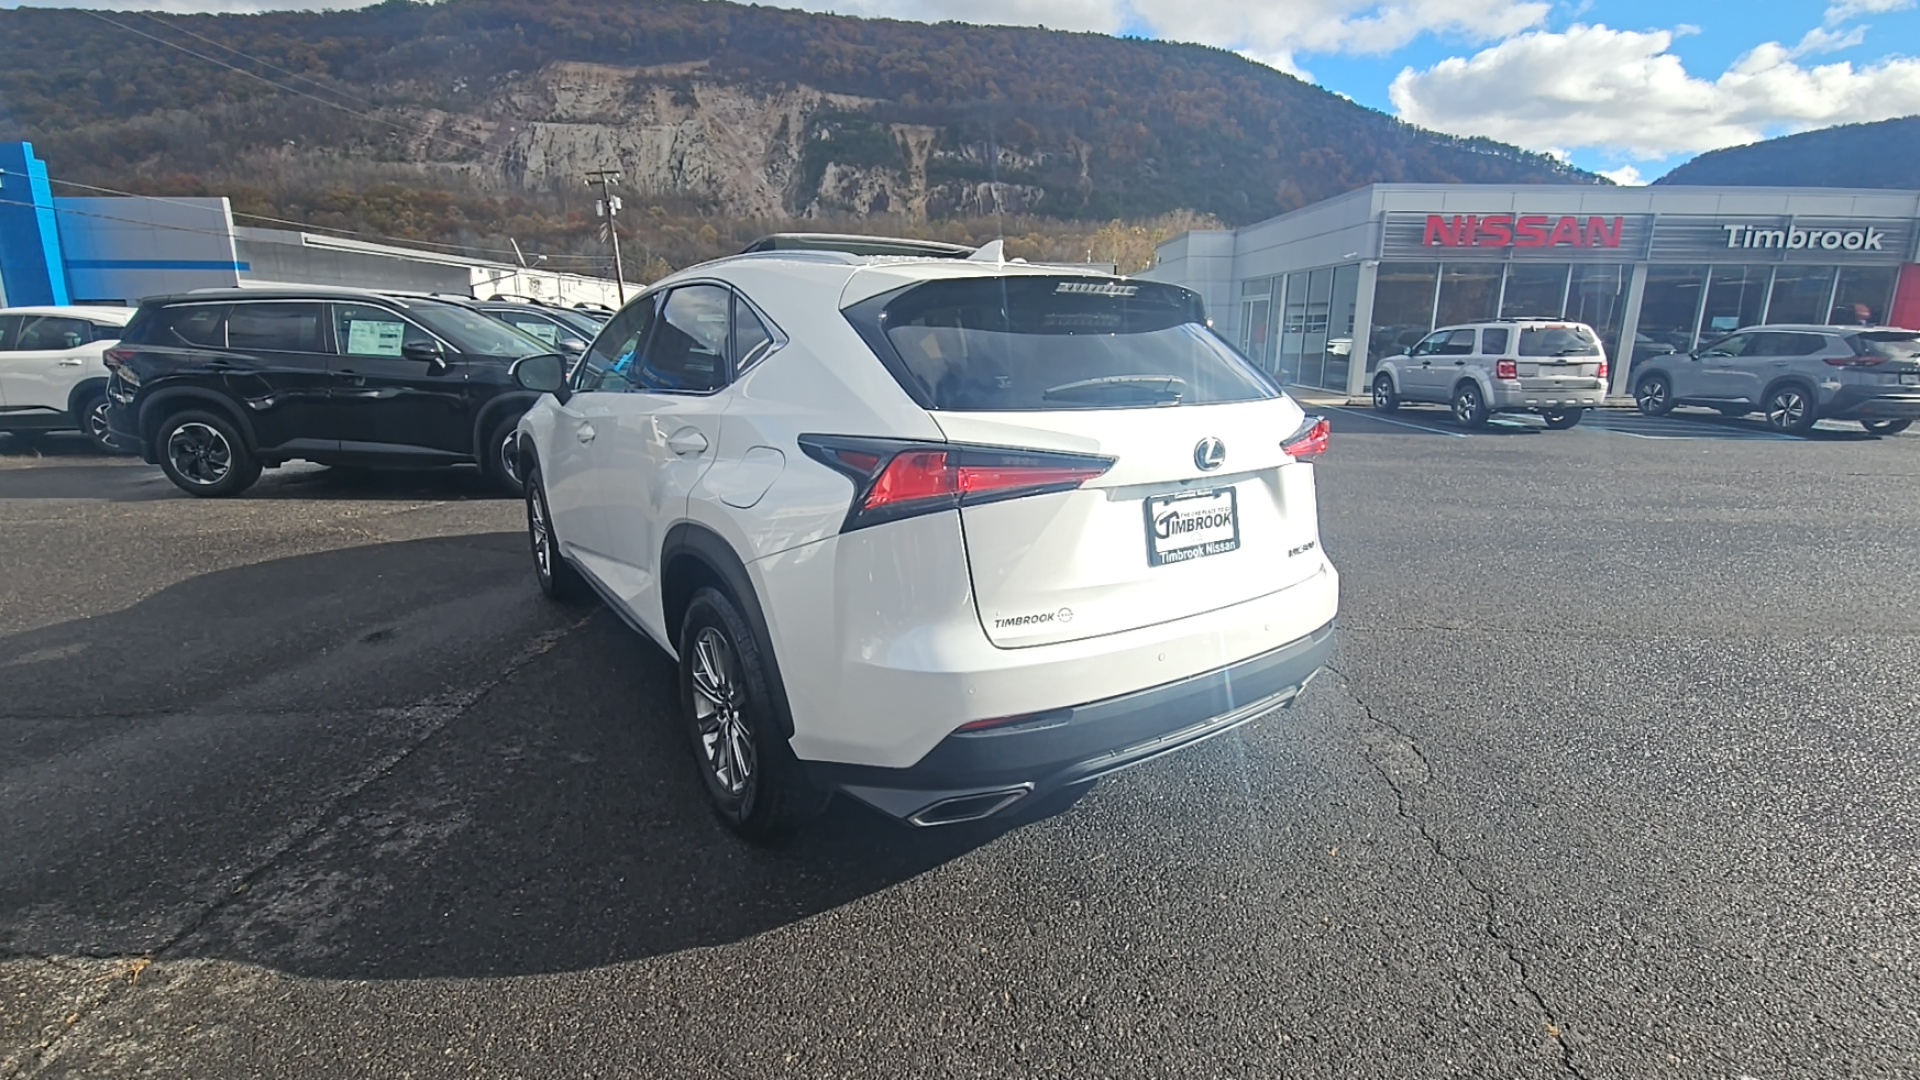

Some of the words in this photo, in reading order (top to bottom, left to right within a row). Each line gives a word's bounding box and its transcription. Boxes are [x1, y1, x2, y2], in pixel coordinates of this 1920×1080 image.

[1423, 215, 1624, 248] NISSAN
[1723, 223, 1884, 251] Timbrook
[1154, 510, 1232, 540] TIMBROOK
[1159, 546, 1204, 564] Timbrook
[1206, 541, 1236, 555] Nissan
[994, 613, 1055, 628] TIMBROOK
